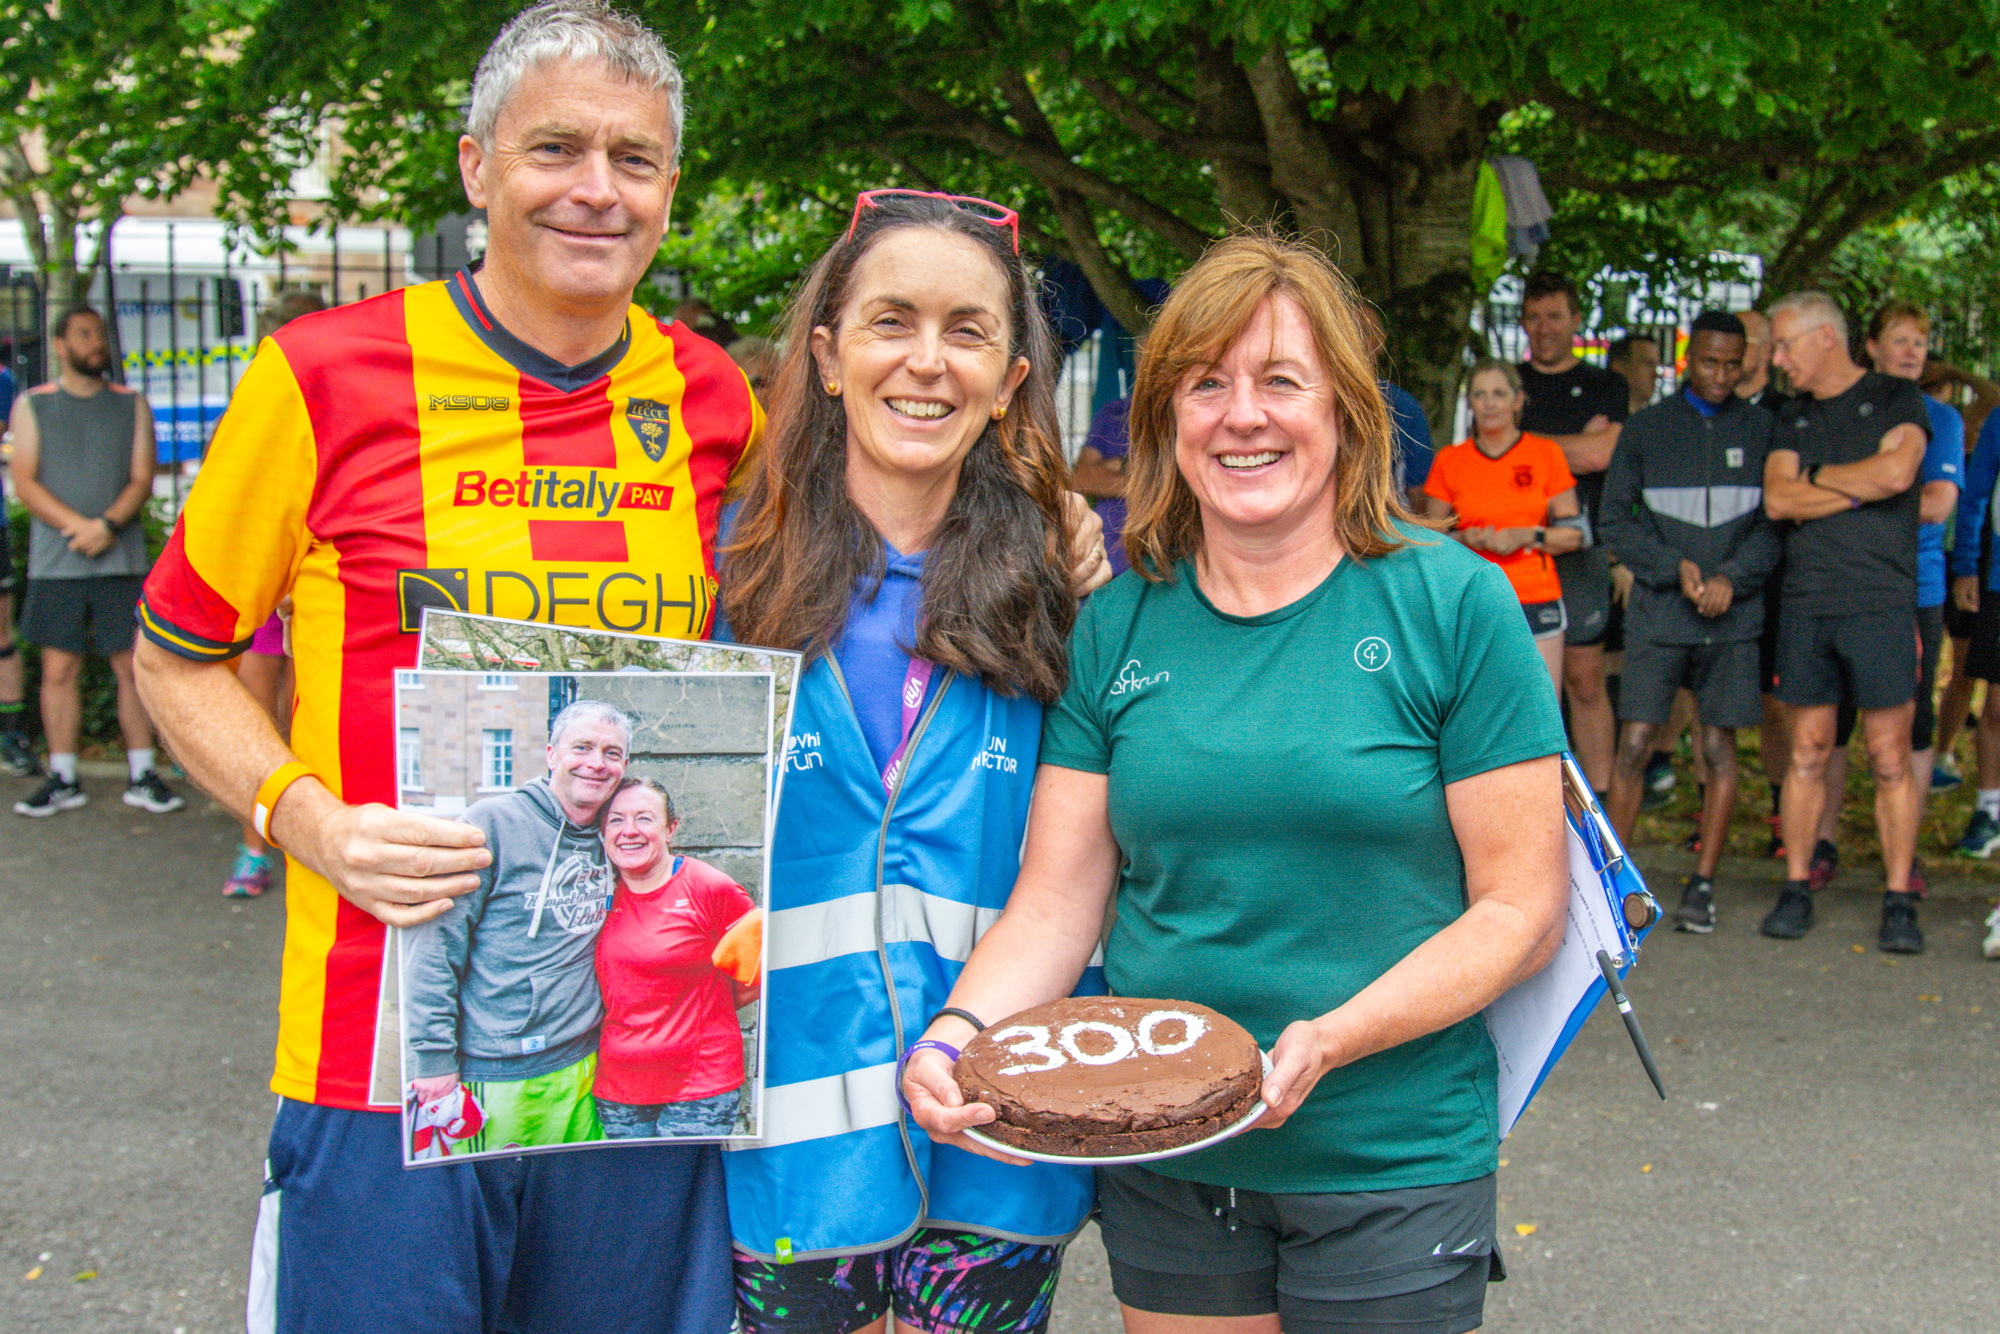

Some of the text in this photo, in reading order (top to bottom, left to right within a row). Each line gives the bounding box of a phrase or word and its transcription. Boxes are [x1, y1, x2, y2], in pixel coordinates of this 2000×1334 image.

[429, 394, 510, 411] M908
[631, 404, 665, 419] LECCE
[453, 469, 664, 517] Betitaly PAY
[904, 677, 923, 706] Vhi
[992, 1010, 1206, 1075] 300
